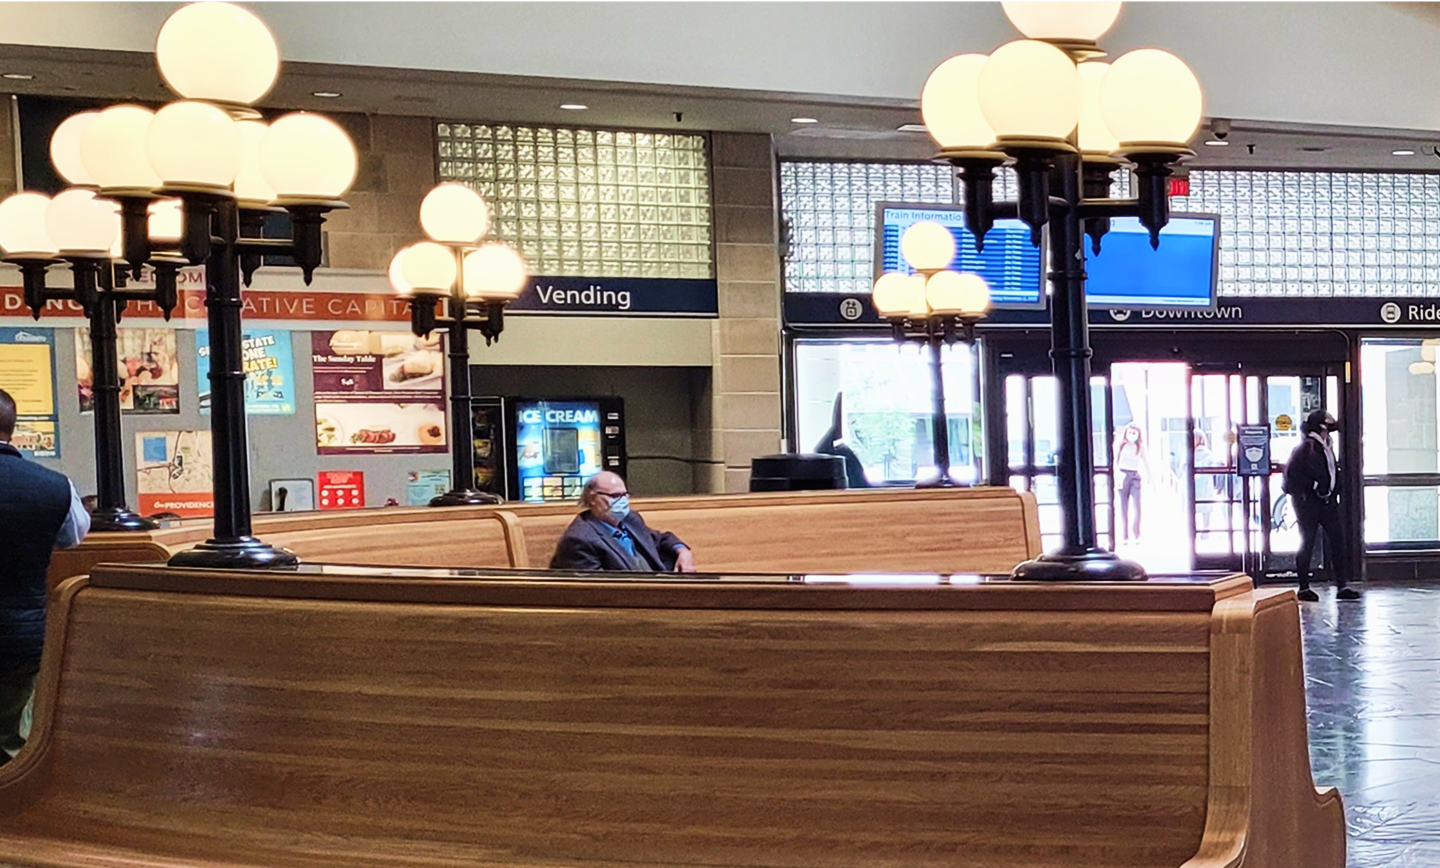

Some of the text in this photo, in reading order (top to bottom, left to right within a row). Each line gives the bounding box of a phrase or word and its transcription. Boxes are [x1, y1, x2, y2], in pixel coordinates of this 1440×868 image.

[885, 210, 962, 221] Train Informatio
[185, 295, 316, 315] CATIVE
[327, 299, 412, 316] CAPITA
[535, 285, 631, 310] Vending
[1141, 306, 1243, 319] Downtown
[242, 357, 278, 373] RATE!
[312, 355, 377, 365] The Sunday Table
[518, 409, 599, 425] ICE CREAM
